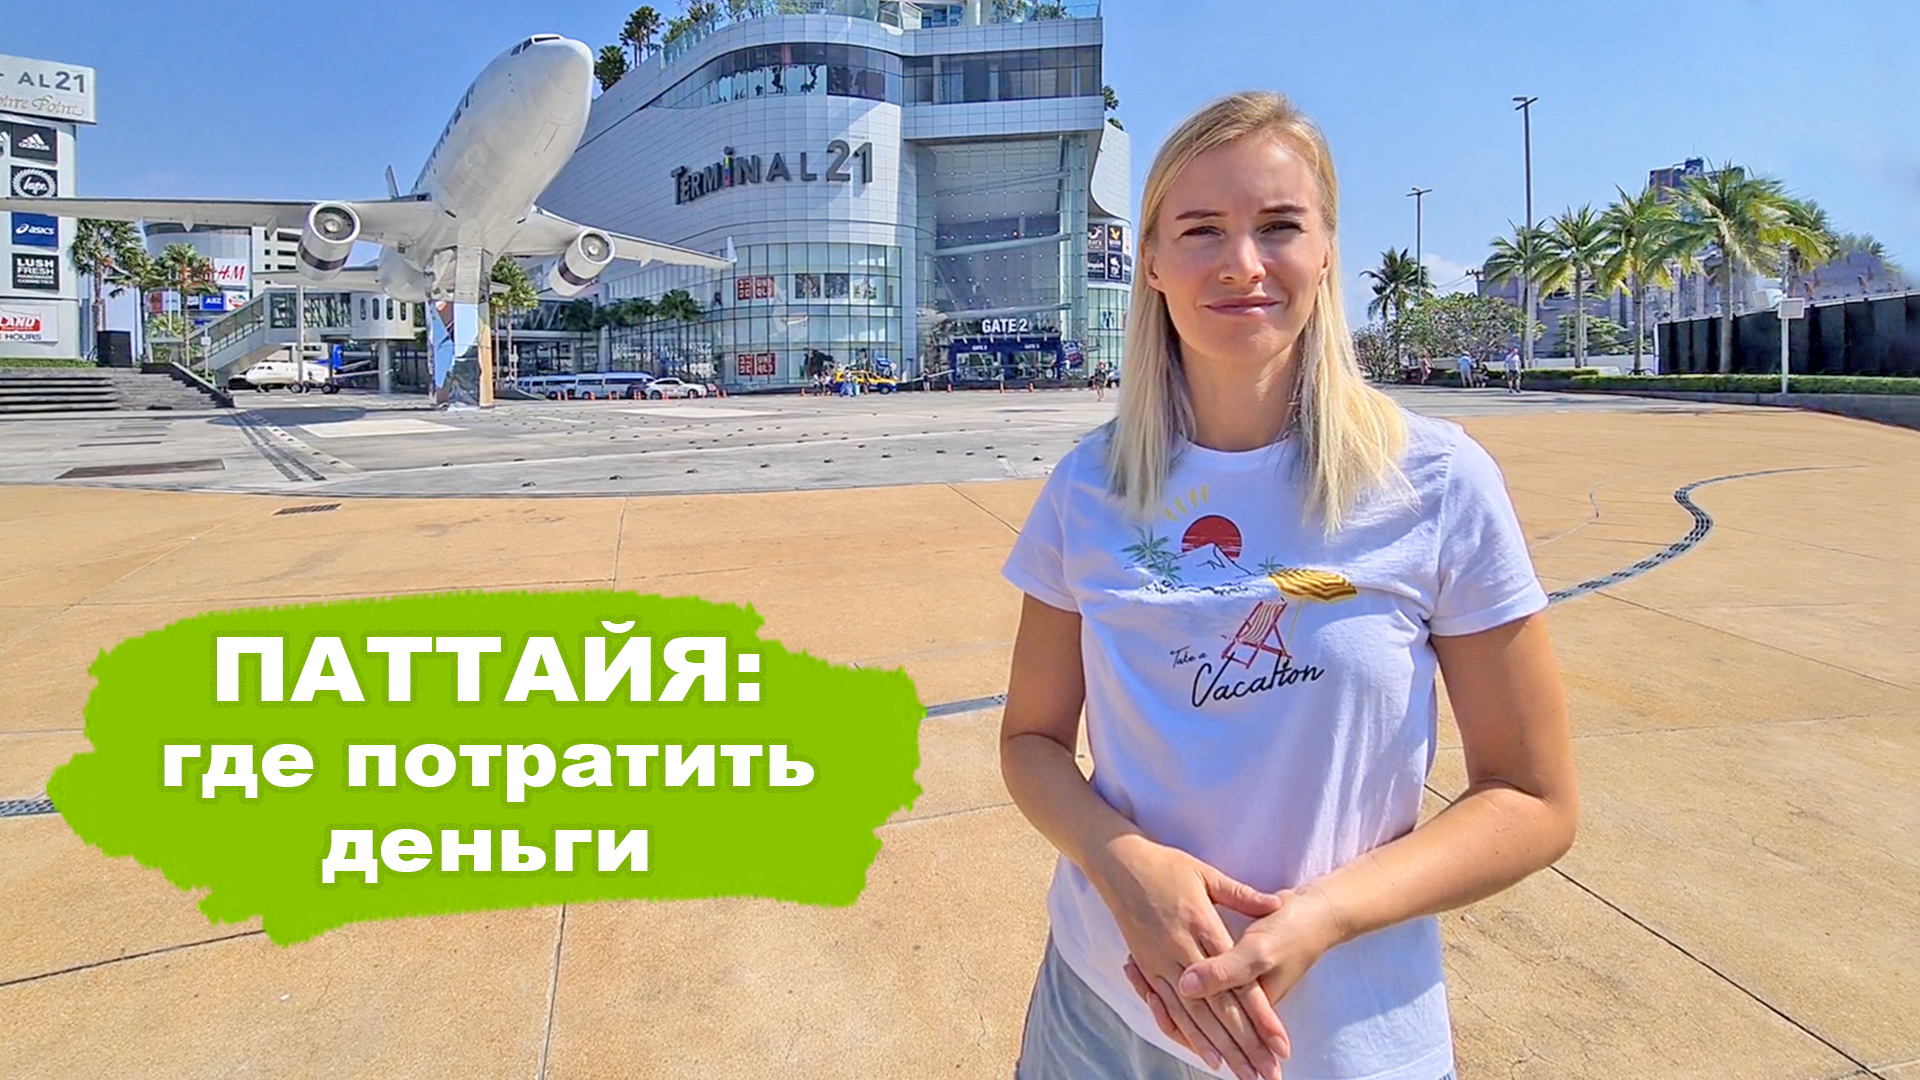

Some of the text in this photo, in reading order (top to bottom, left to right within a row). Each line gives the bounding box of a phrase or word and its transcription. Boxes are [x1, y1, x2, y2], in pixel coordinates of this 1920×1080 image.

[826, 139, 873, 184] 21
[16, 258, 54, 268] LUSH
[16, 266, 54, 275] FRESH
[981, 318, 1028, 334] GATE 2
[5, 333, 42, 341] HOURS
[1170, 645, 1208, 668] Take a
[1191, 650, 1325, 708] Vacation
